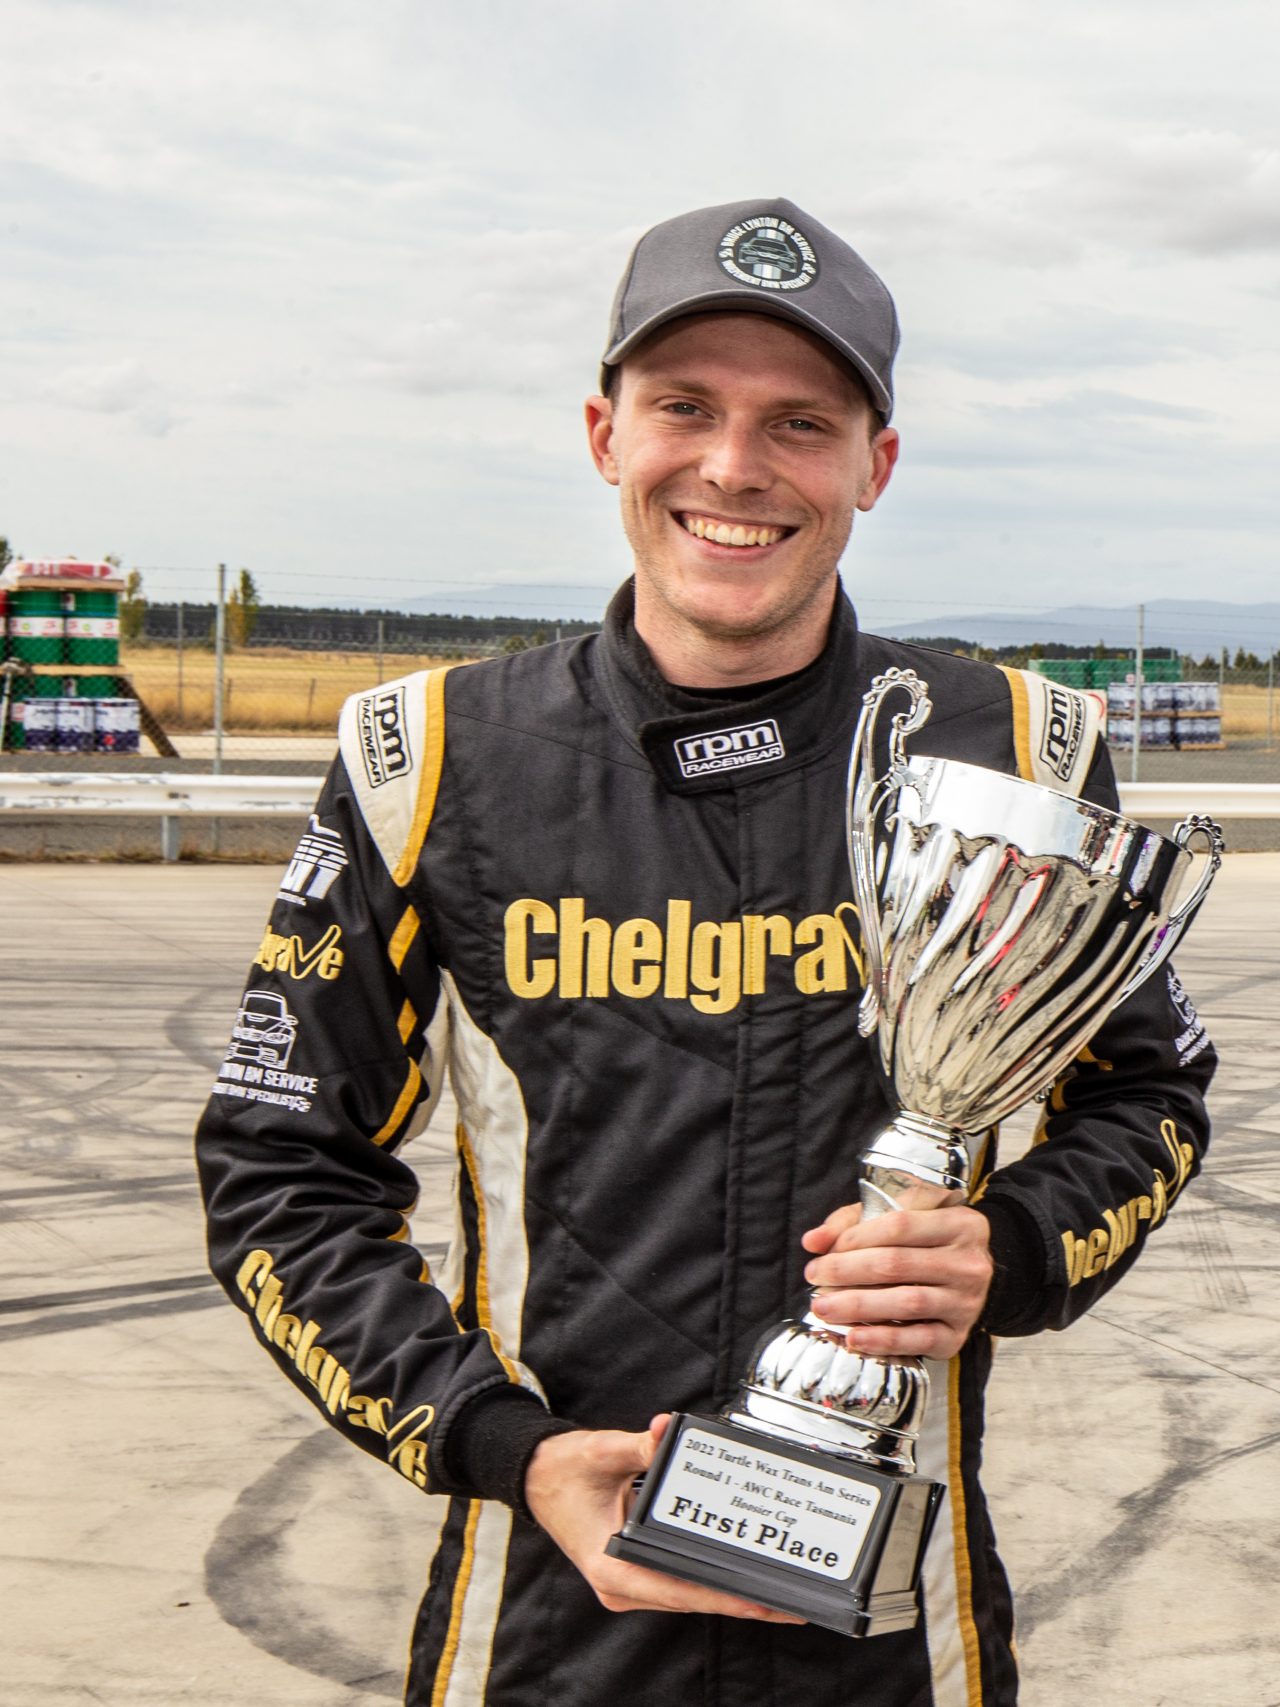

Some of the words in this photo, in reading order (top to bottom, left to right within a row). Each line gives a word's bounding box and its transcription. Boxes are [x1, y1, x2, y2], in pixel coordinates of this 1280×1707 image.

[362, 699, 381, 783] RACEWEAR
[374, 693, 407, 773] rpm
[684, 726, 775, 760] rpm
[686, 747, 781, 773] RACEWEAR
[1047, 688, 1068, 764] rpm
[503, 896, 866, 1015] Chelgra
[263, 1069, 319, 1094] SERVICE
[683, 1461, 723, 1482] Round
[724, 1475, 732, 1485] 1
[741, 1480, 771, 1499] AWC
[773, 1490, 801, 1508] Race
[804, 1500, 858, 1526] Tasmania
[685, 1438, 715, 1456] 2022
[718, 1448, 752, 1468] Turtle
[755, 1460, 778, 1478] Wax
[782, 1468, 813, 1488] Trans
[814, 1480, 835, 1495] Am
[837, 1487, 872, 1507] Series
[668, 1496, 749, 1538] First
[754, 1523, 839, 1567] Place
[730, 1495, 773, 1517] Hoosier
[774, 1510, 799, 1528] Cup
